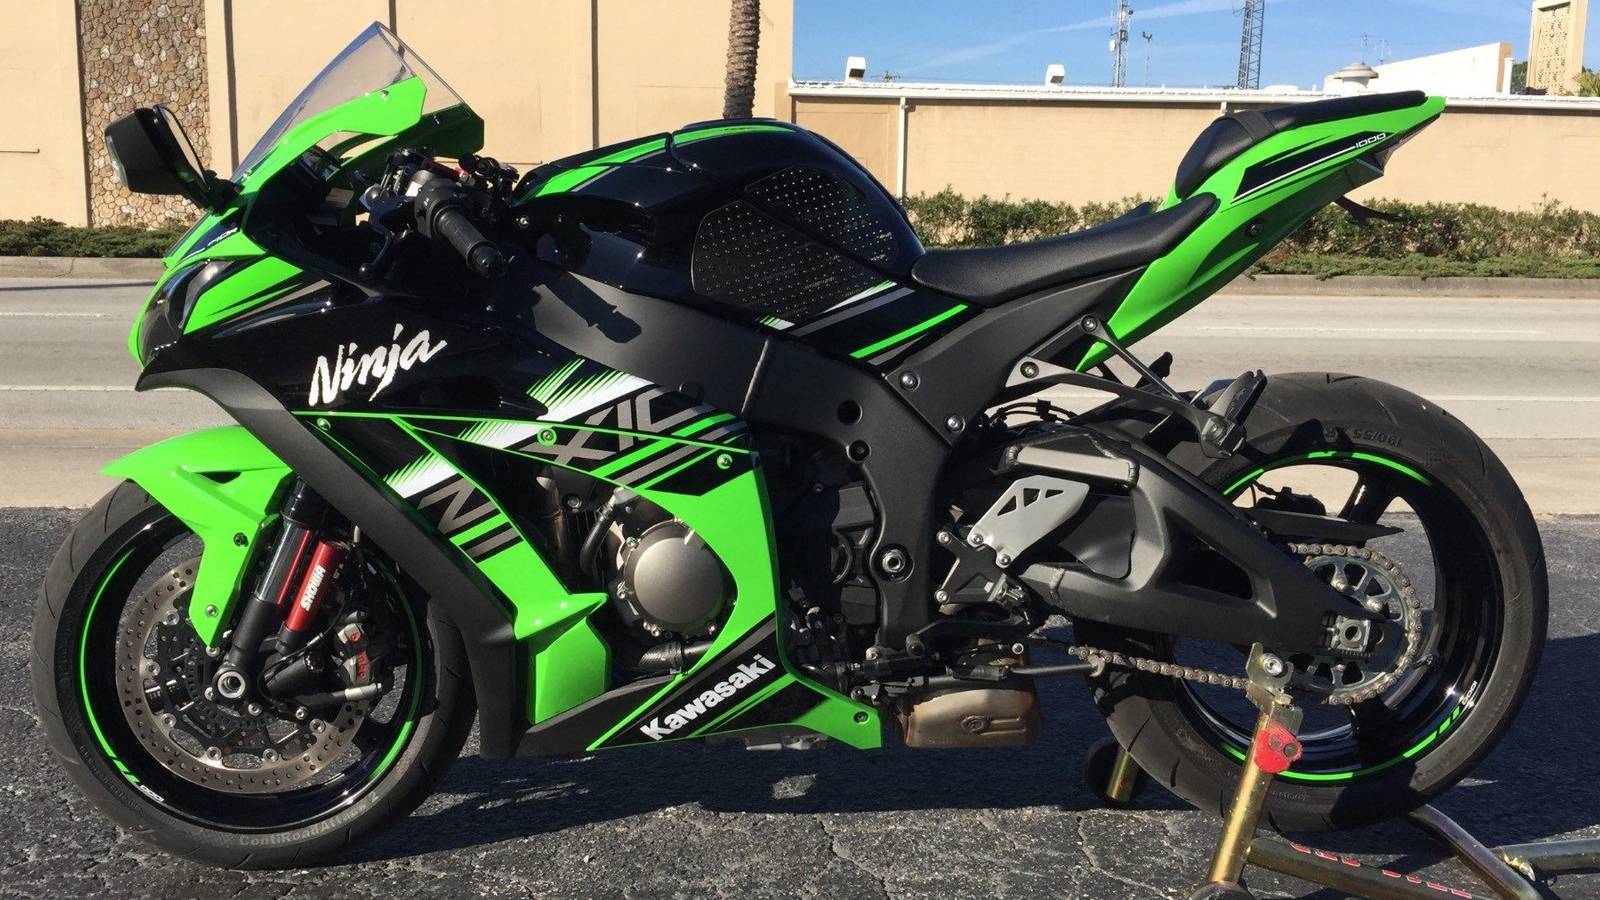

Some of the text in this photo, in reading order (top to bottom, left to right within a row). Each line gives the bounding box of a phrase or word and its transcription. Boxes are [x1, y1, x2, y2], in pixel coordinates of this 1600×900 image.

[1355, 132, 1386, 149] 1000
[308, 323, 448, 406] Ninja
[300, 564, 326, 612] SHOWA
[639, 653, 777, 741] Kawasaki
